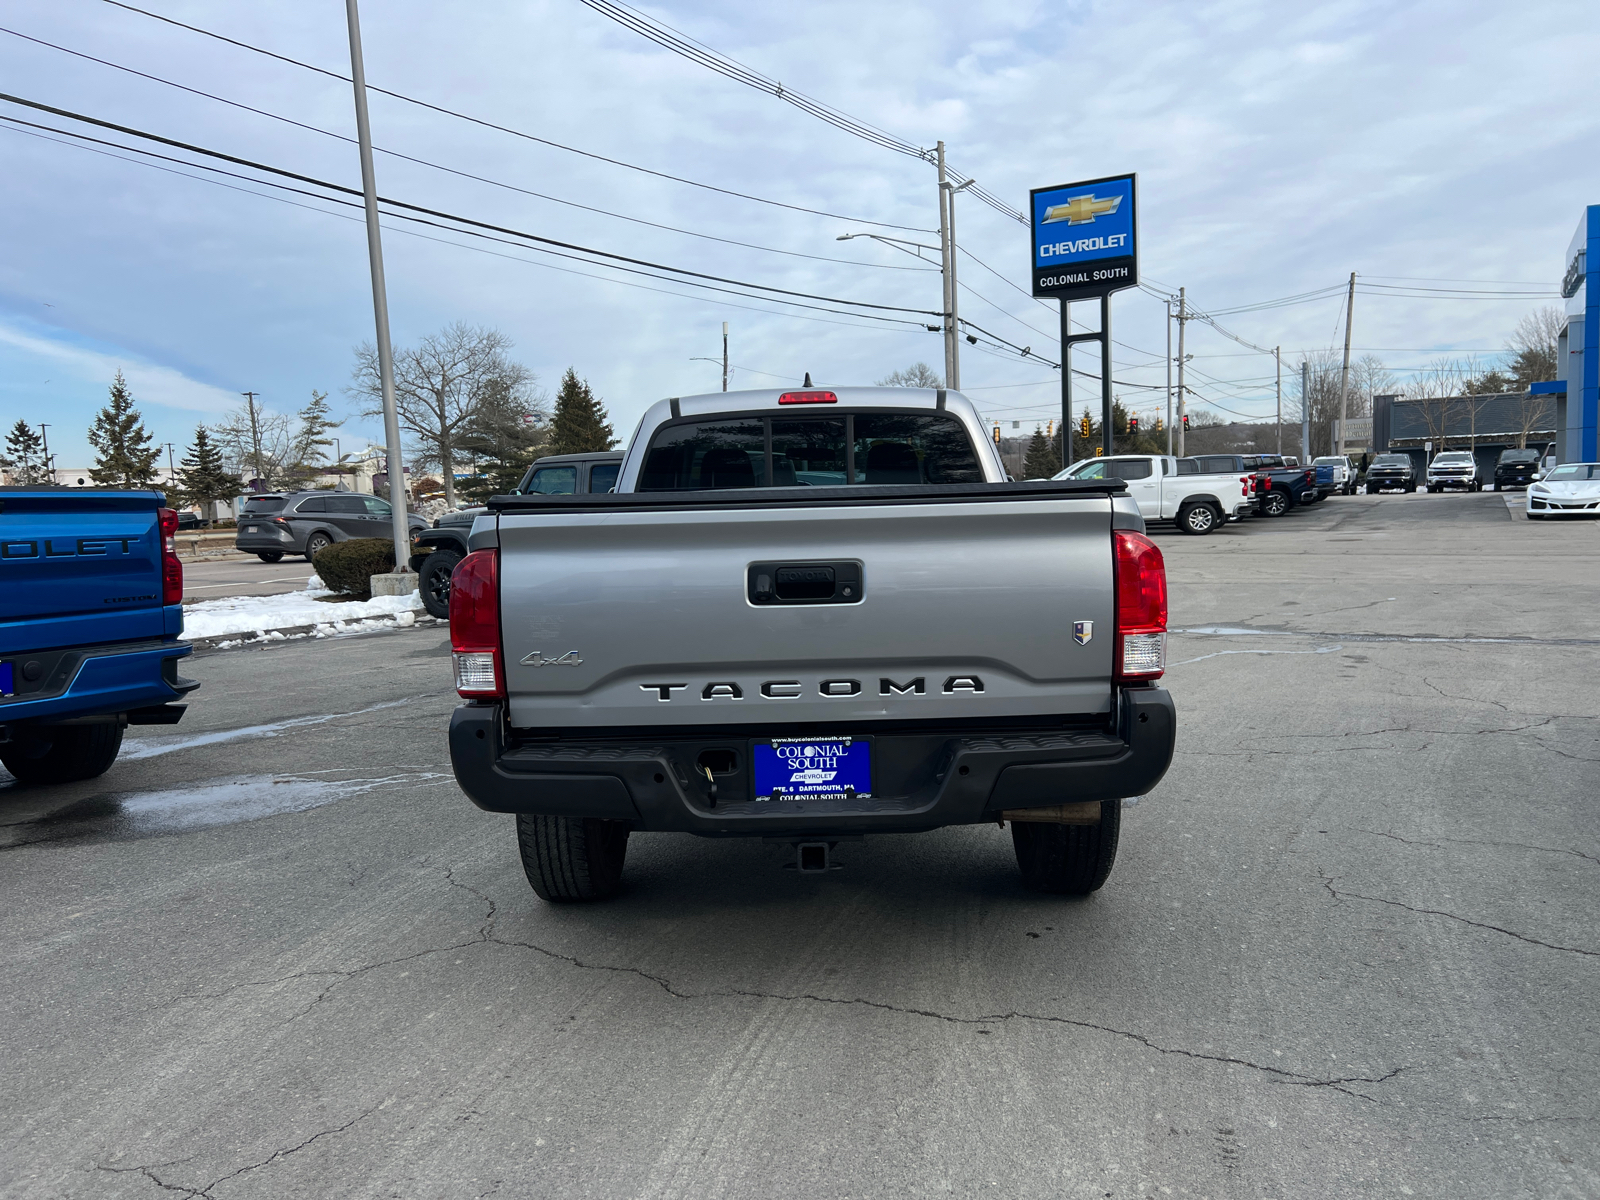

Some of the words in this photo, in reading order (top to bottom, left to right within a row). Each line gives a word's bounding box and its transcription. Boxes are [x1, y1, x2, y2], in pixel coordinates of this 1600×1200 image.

[1040, 233, 1127, 257] CHEVROLET
[1040, 273, 1090, 287] COLONIAL
[1093, 267, 1128, 280] SOUTH
[1, 537, 140, 560] OLET
[780, 570, 832, 581] TOYOTA
[103, 594, 157, 604] CUSTOM
[519, 650, 584, 667] 4x4
[639, 675, 985, 702] TACOMA
[771, 736, 852, 744] www.buycolonialsouth.com
[776, 745, 848, 758] COLONIAL
[788, 757, 838, 769] SOUTH
[799, 784, 843, 792] DARTMOUTH,
